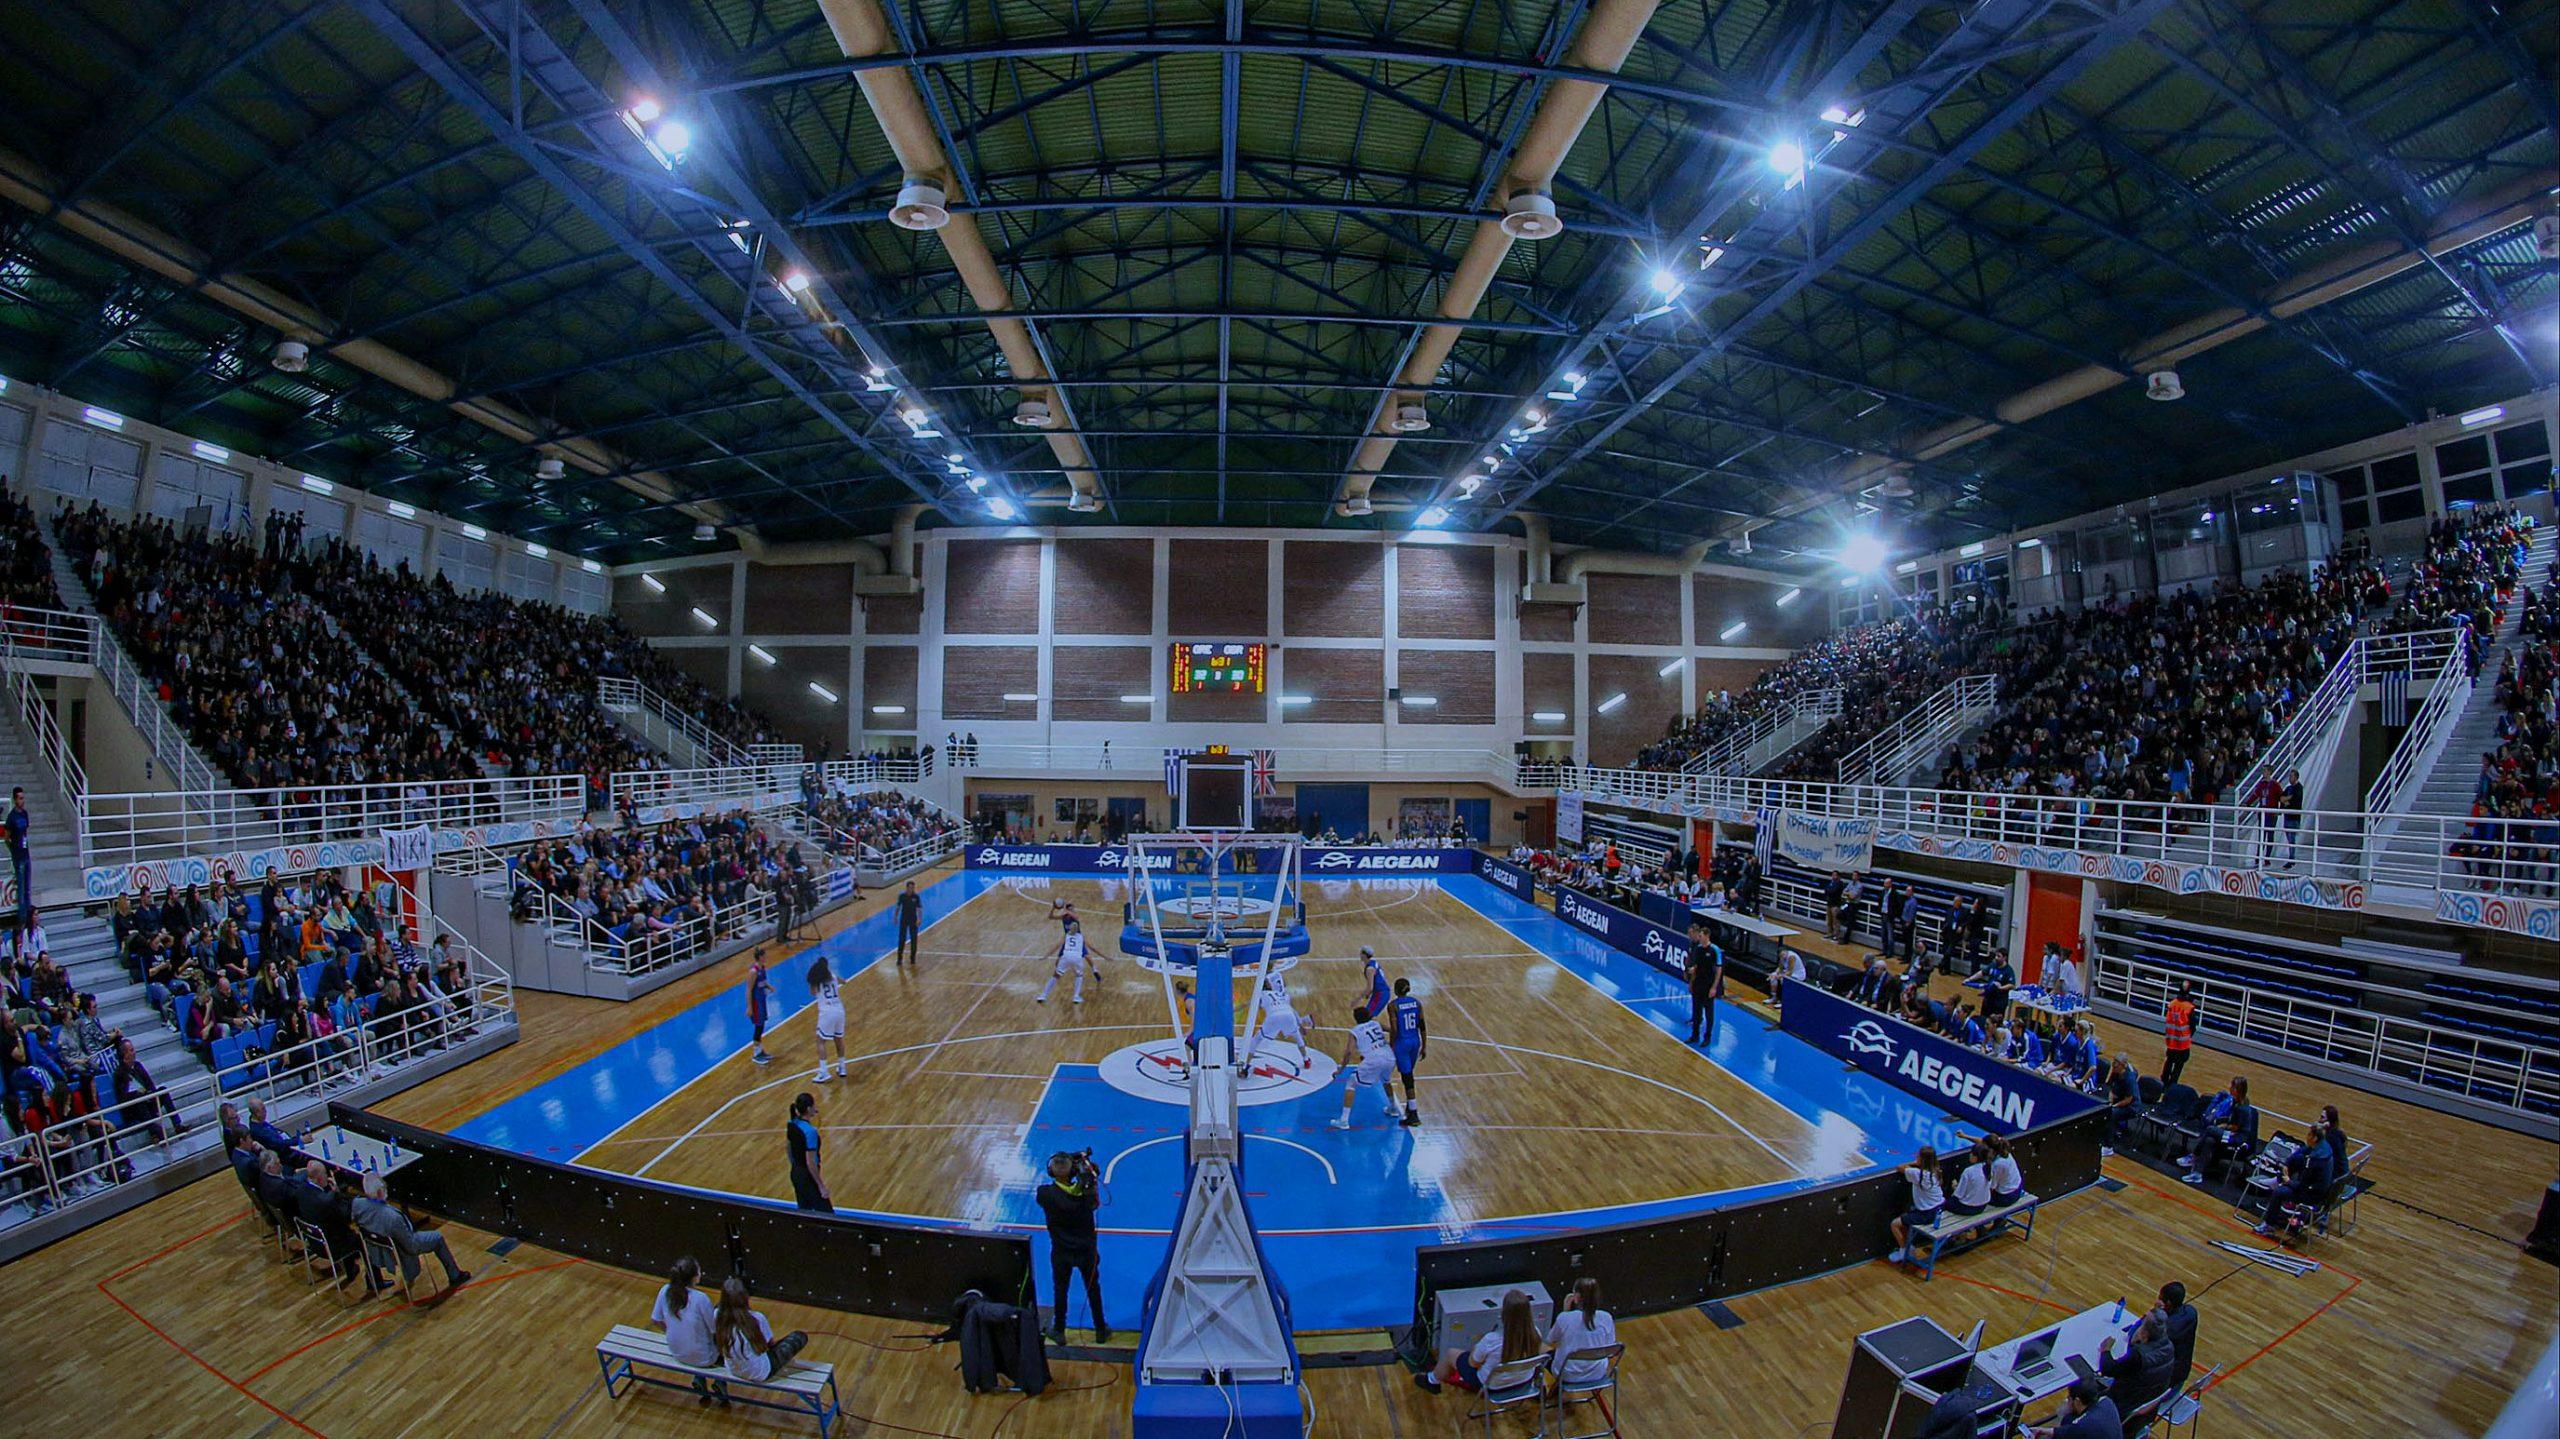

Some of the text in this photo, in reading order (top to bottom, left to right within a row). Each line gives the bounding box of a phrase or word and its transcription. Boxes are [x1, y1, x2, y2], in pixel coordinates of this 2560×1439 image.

[388, 829, 428, 869] ΝΙΚΗ
[1001, 853, 1051, 867] AEGEAN
[1356, 855, 1440, 869] AEGEAN
[1493, 867, 1519, 890] AEGEAN
[1575, 904, 1609, 935] AEGEAN
[823, 984, 839, 999] 21
[1403, 1012, 1417, 1031] 16
[1365, 1027, 1385, 1044] 15
[1898, 1048, 2035, 1131] AEGEAN
